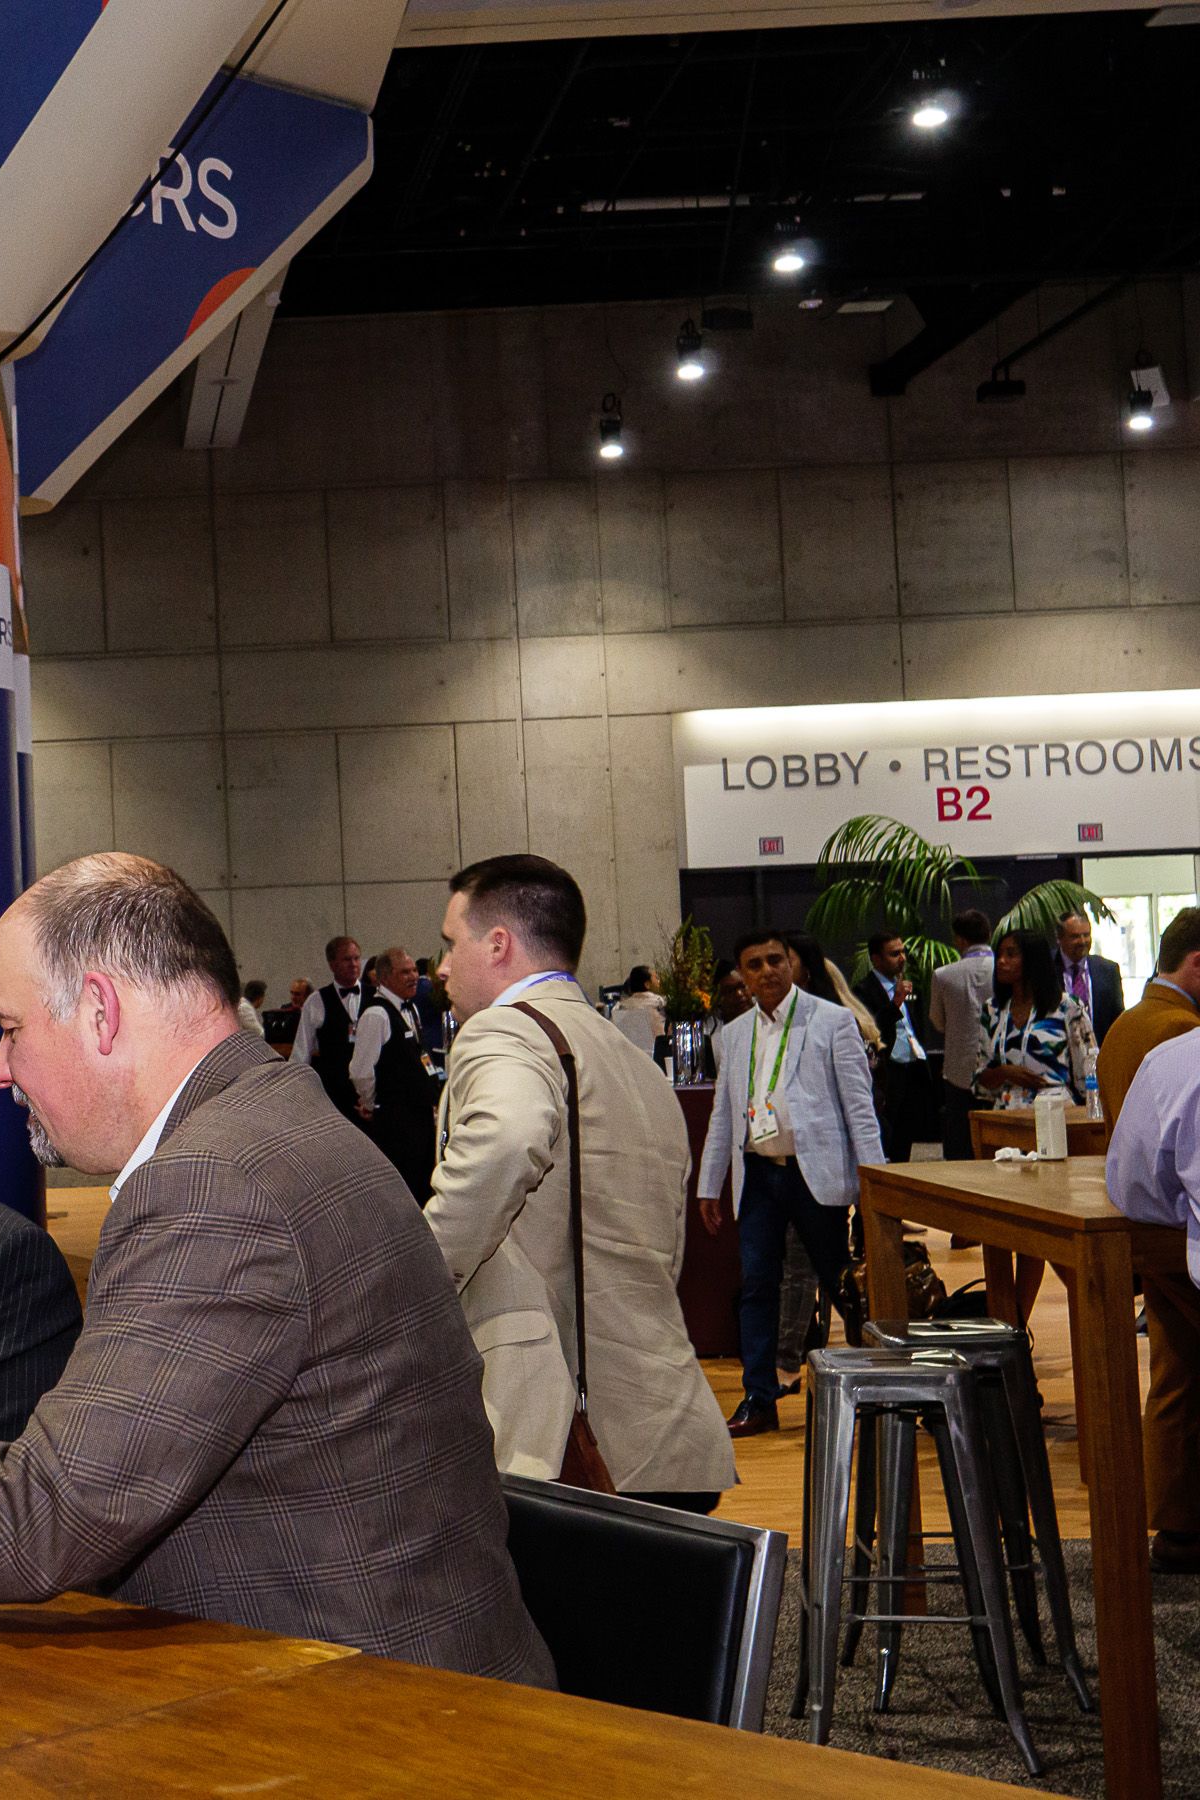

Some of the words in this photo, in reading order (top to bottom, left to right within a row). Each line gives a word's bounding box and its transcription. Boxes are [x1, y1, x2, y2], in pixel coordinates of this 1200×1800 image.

[123, 147, 238, 240] RS
[721, 750, 869, 791] LOBBY
[936, 785, 993, 823] B2
[762, 840, 779, 852] EXIT
[1081, 826, 1099, 840] EXIT
